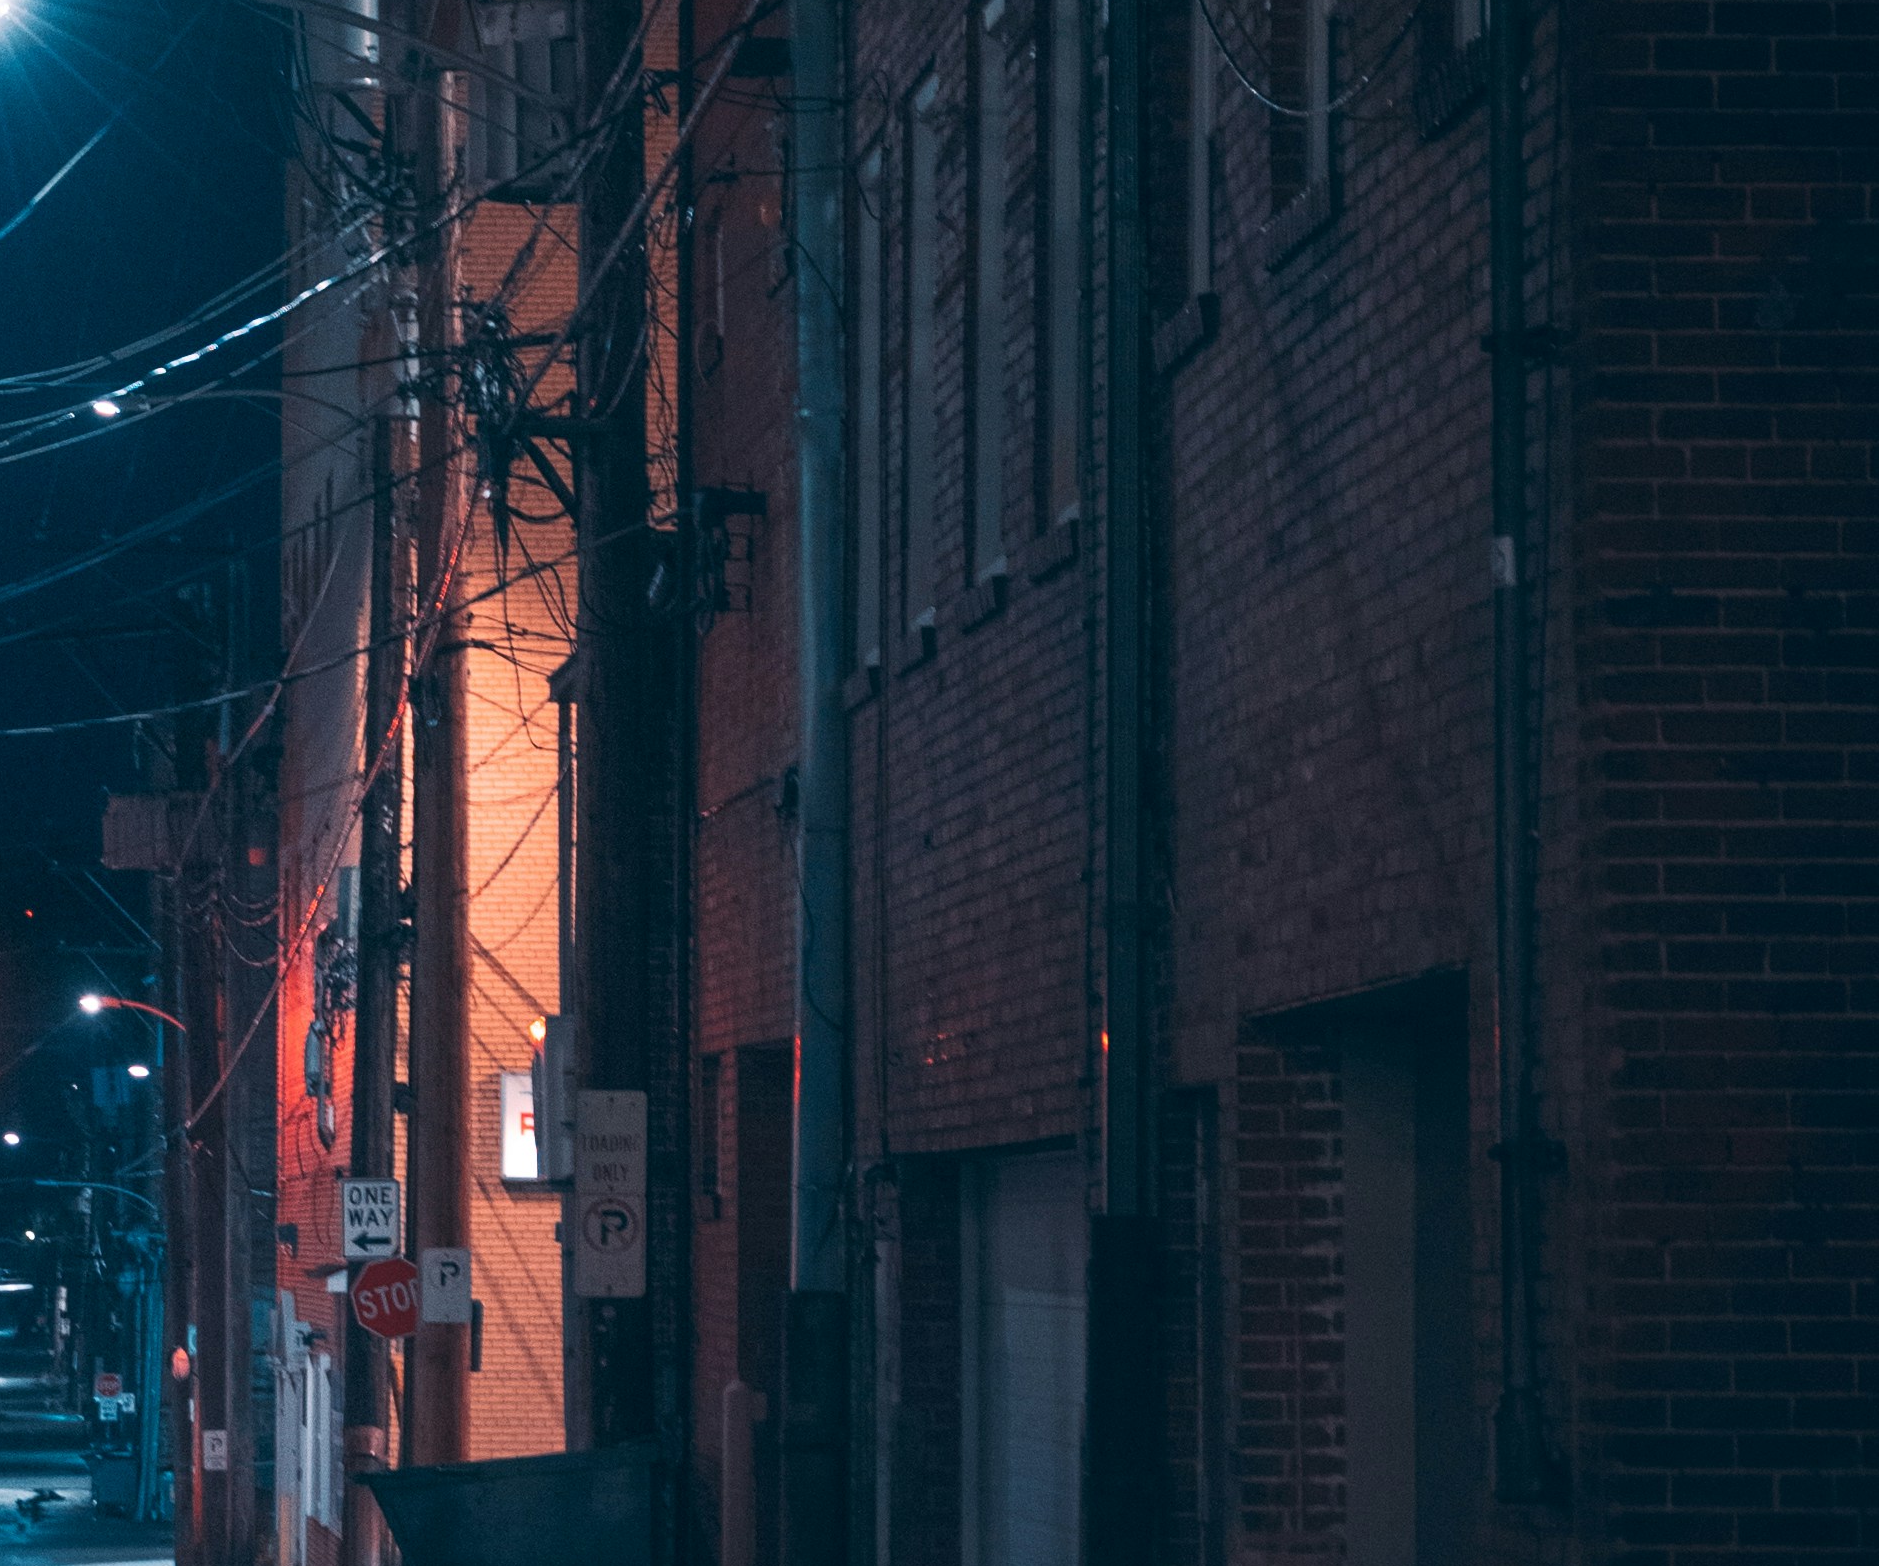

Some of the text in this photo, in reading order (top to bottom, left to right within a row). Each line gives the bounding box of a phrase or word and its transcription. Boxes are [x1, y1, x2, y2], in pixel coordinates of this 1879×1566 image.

[592, 1162, 628, 1182] ONLY
[349, 1186, 393, 1205] ONE
[349, 1208, 394, 1227] WAY
[601, 1209, 629, 1246] P
[440, 1261, 460, 1286] P
